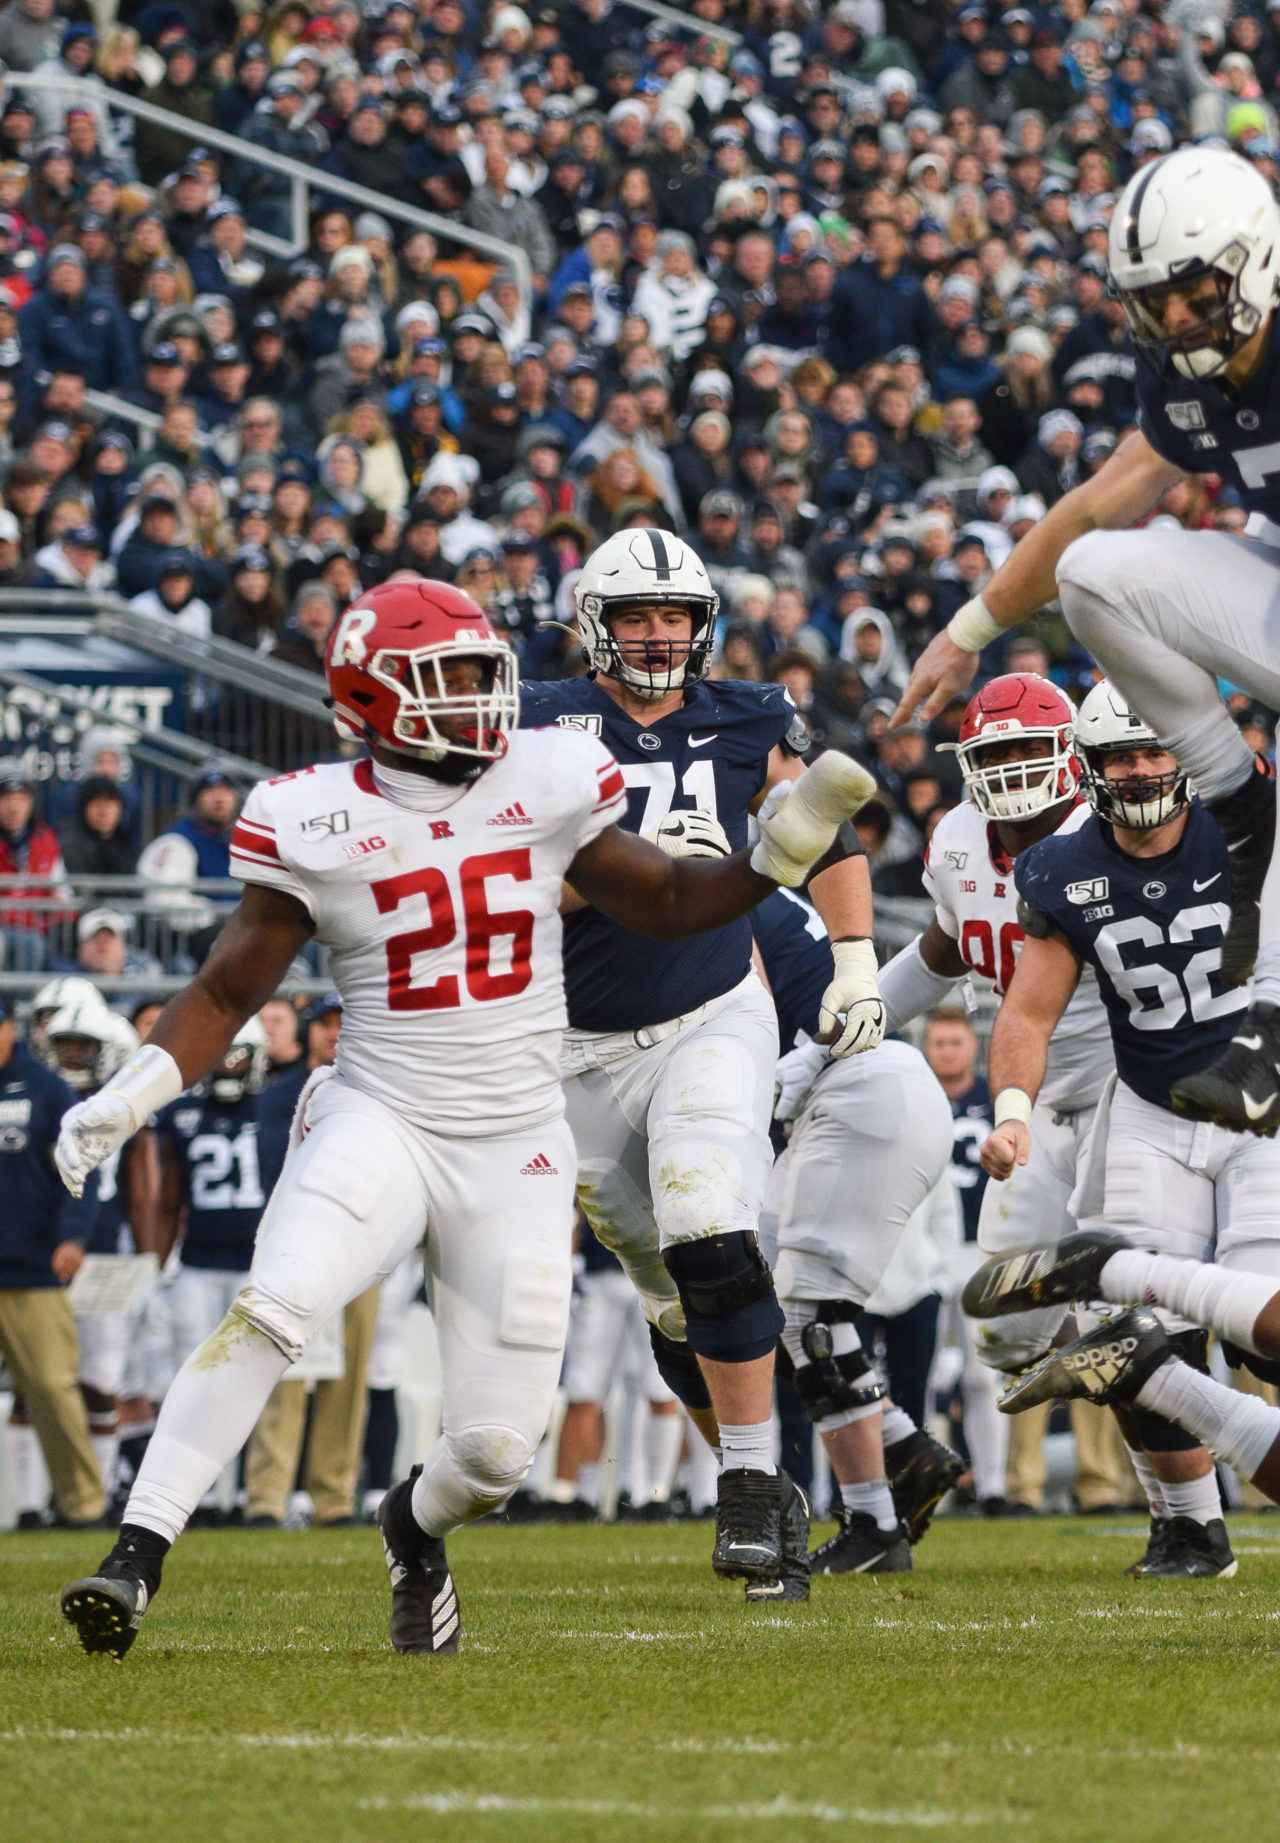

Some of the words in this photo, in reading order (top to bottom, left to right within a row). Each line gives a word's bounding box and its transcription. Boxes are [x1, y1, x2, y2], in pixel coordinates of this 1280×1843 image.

[331, 609, 377, 667] R
[617, 759, 719, 836] 71
[300, 809, 350, 838] 150
[428, 820, 455, 841] R
[486, 813, 533, 826] adidas
[993, 882, 1006, 898] R
[1066, 877, 1110, 904] 150
[370, 847, 535, 1011] 26
[1093, 901, 1252, 1031] 62
[187, 1132, 265, 1211] 21
[519, 1166, 559, 1175] adidas
[1062, 1337, 1138, 1370] adidas
